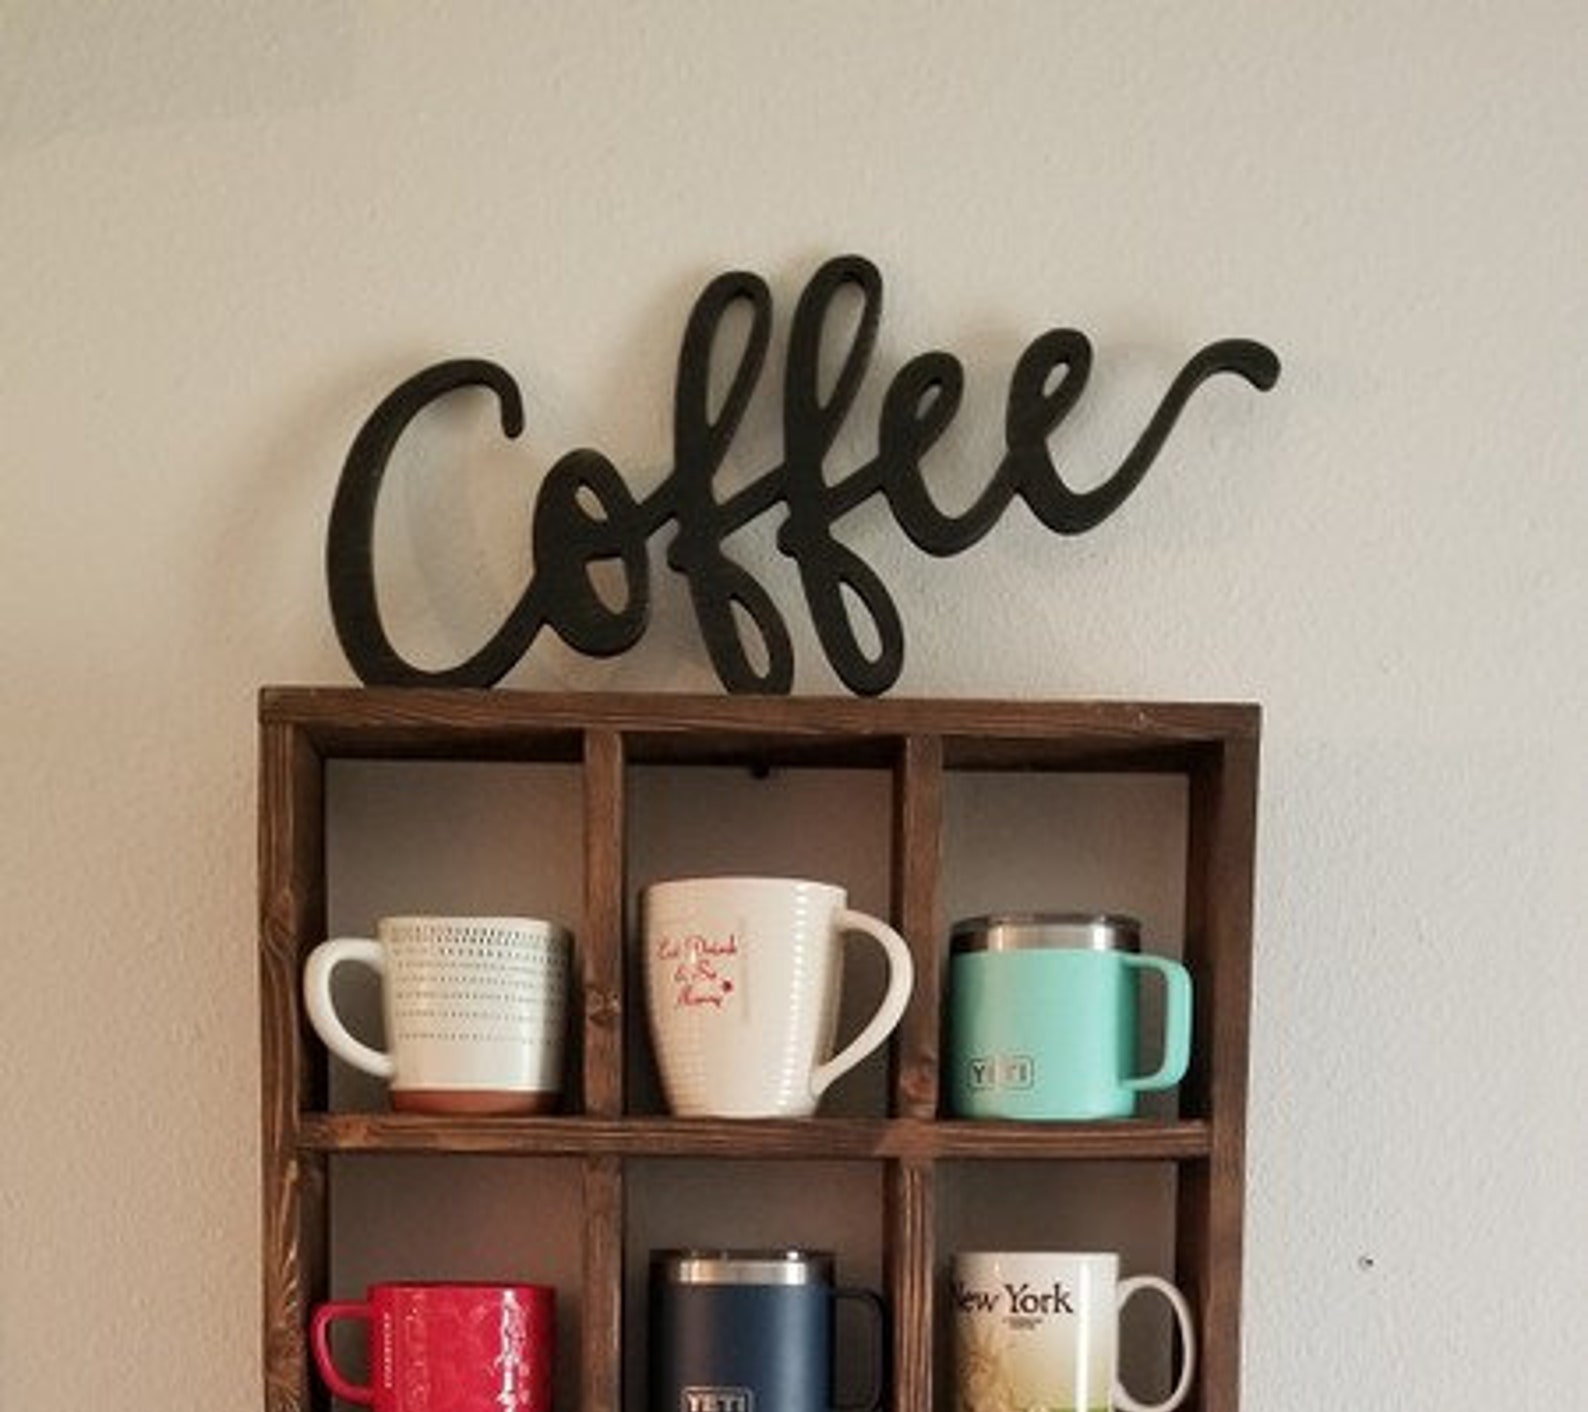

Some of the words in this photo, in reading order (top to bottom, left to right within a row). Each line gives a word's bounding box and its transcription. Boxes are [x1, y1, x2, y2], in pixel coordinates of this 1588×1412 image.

[326, 254, 1281, 697] Coffee
[1004, 1283, 1074, 1314] York
[686, 1392, 746, 1412] YETI
